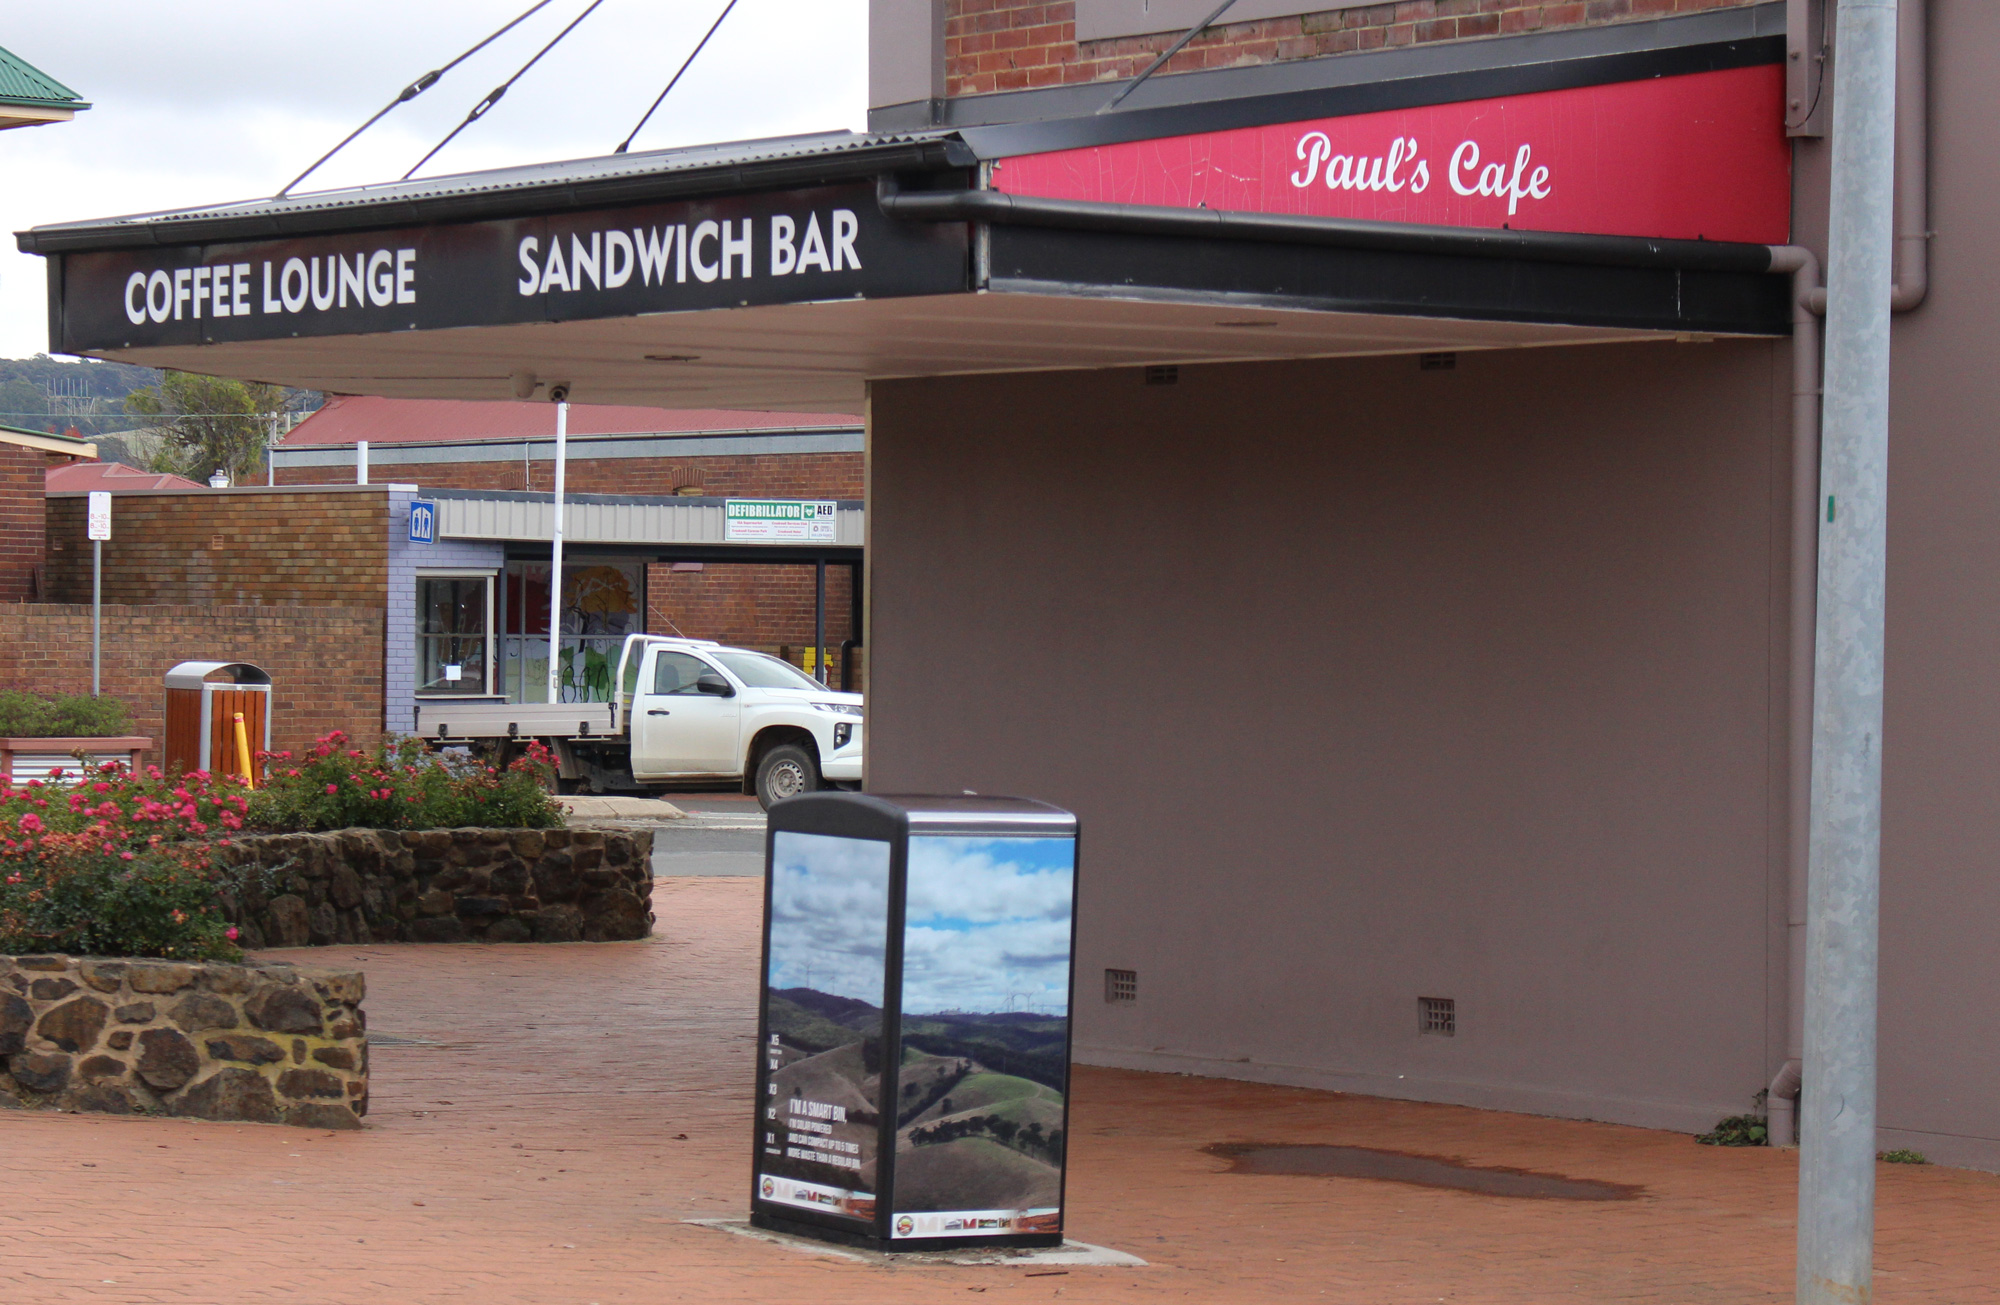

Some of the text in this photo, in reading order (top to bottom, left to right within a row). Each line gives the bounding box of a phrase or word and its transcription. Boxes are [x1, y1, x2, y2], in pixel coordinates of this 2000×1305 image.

[1291, 131, 1551, 215] Paul's Cafe
[518, 209, 862, 296] SANDWICH BAR
[125, 248, 416, 325] COFFEE LOUNGE
[728, 504, 833, 518] DEFIBRILLATOR AED
[771, 1034, 779, 1046] X5
[770, 1058, 778, 1070] X4
[768, 1107, 776, 1120] X2
[790, 1098, 801, 1114] I'M
[801, 1100, 807, 1116] A
[808, 1101, 833, 1119] SMART
[811, 1121, 833, 1135] POWERED
[767, 1132, 775, 1144] X1
